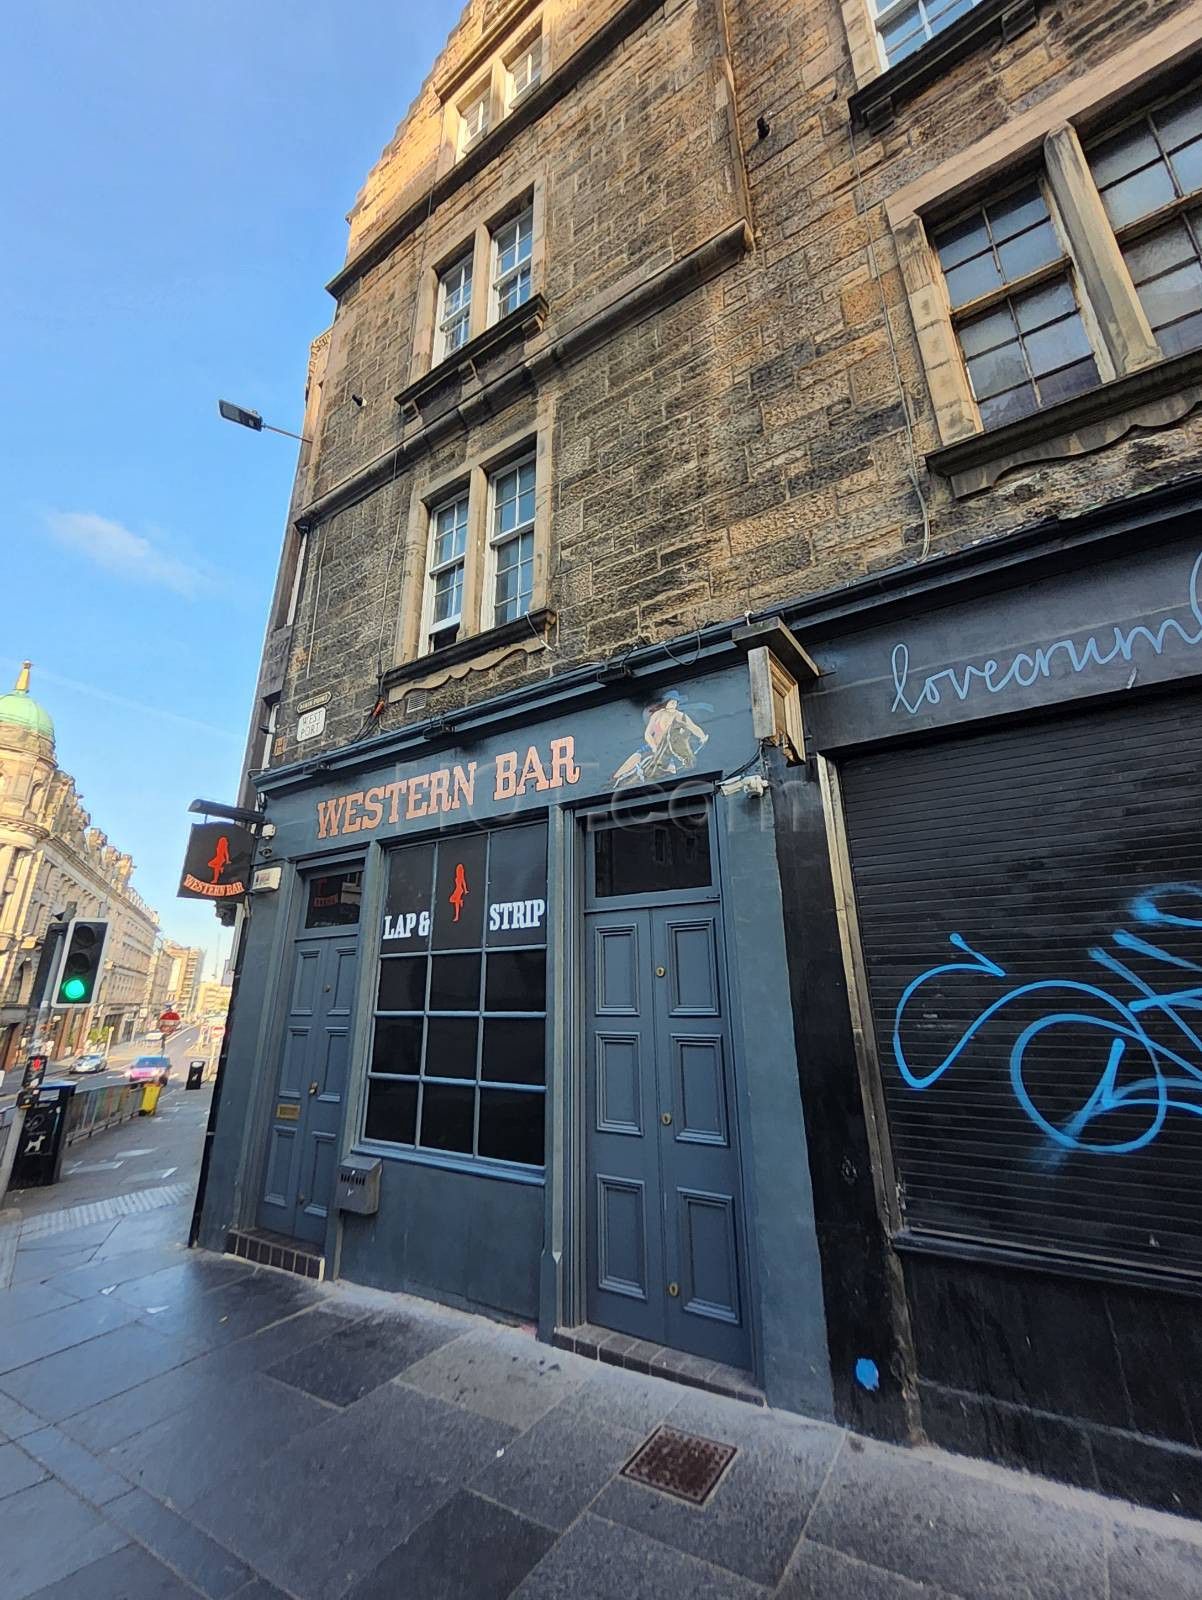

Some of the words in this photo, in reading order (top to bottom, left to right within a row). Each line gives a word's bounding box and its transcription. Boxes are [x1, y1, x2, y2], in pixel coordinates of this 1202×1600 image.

[890, 552, 1202, 714] lovecrum
[300, 722, 321, 738] PORT
[302, 710, 322, 724] WEST
[317, 761, 478, 840] WESTERN
[493, 735, 581, 801] BAR
[183, 873, 225, 896] WESTERN
[225, 881, 245, 896] BAR
[382, 913, 417, 940] LAP
[418, 911, 431, 936] &
[489, 899, 545, 931] STRIP
